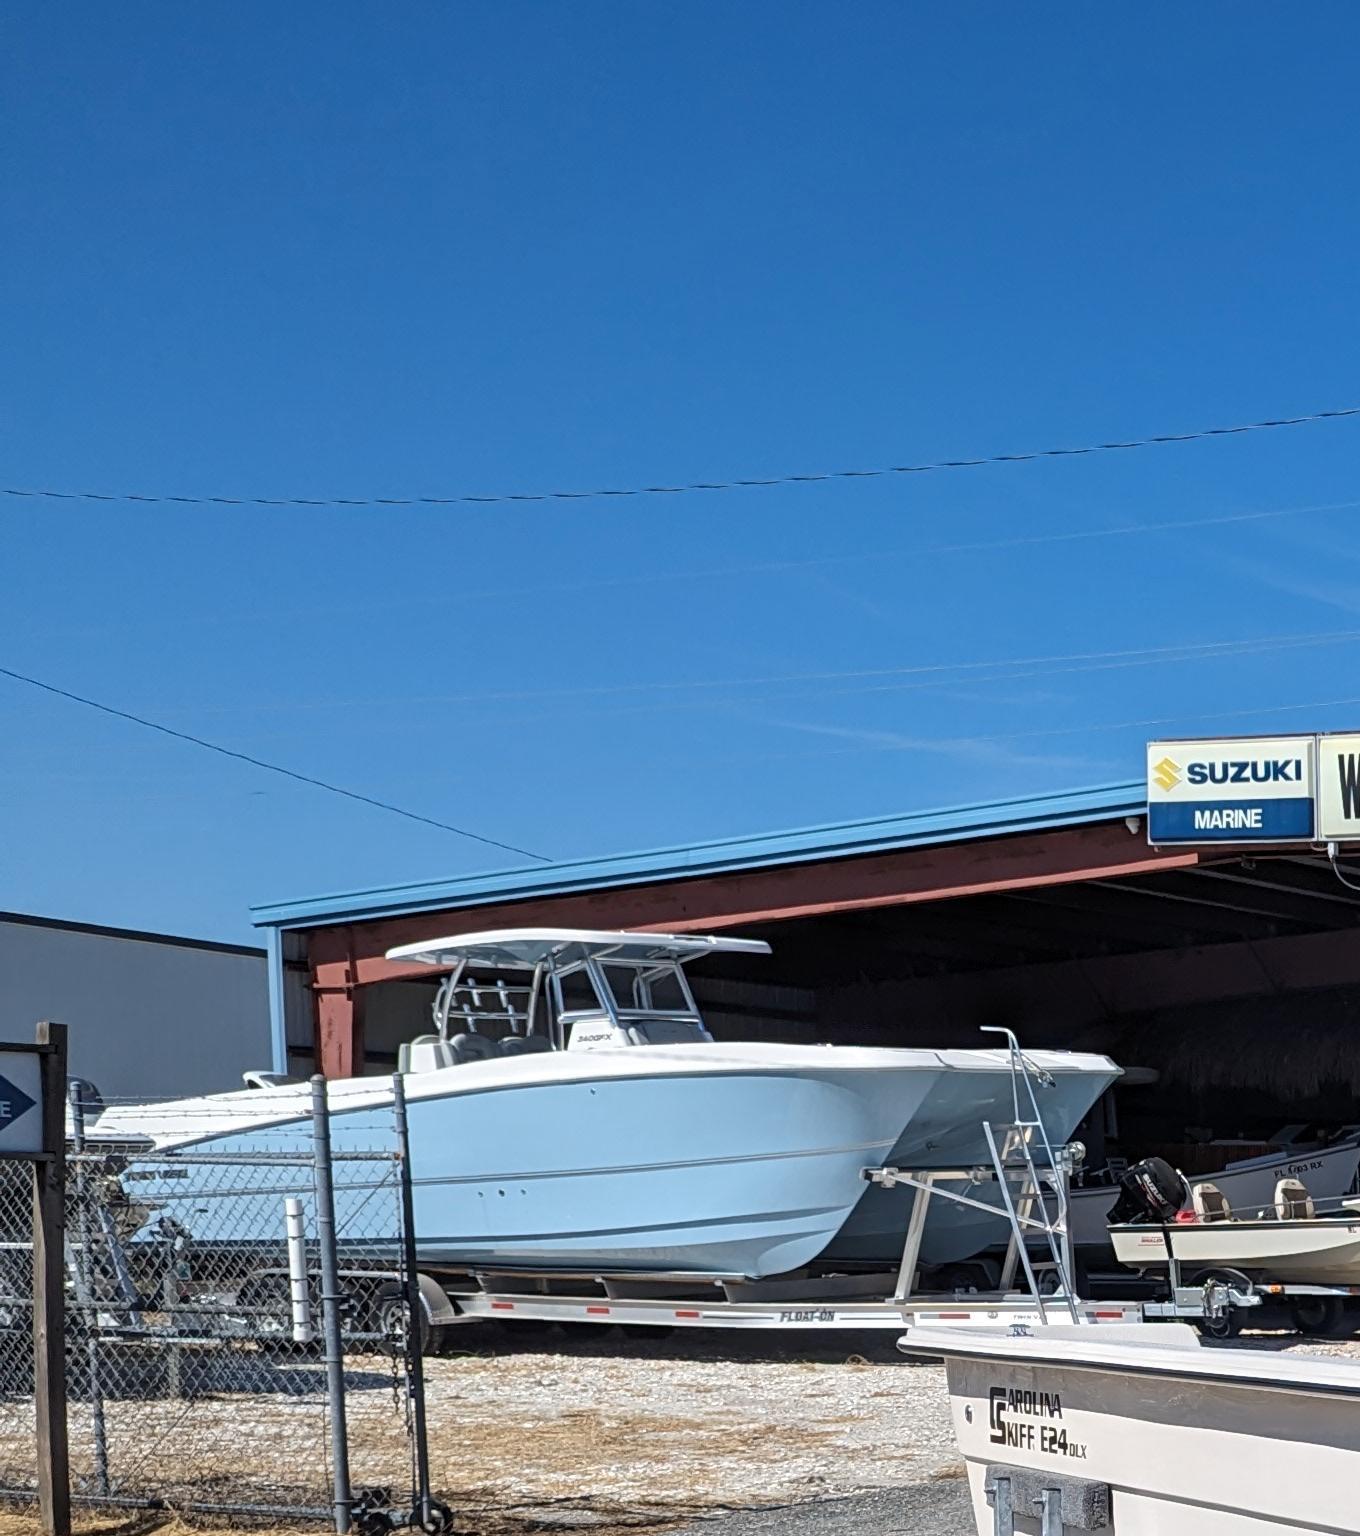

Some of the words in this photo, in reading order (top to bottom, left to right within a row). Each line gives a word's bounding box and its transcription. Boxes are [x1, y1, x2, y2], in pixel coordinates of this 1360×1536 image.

[1187, 759, 1303, 785] SUZUKI
[1194, 808, 1263, 830] MARINE
[1142, 1172, 1169, 1205] SUZUKI
[779, 1309, 835, 1322] FLOAT-ON
[990, 1386, 1063, 1429] CAROLINA
[990, 1401, 1035, 1451] SKIFF
